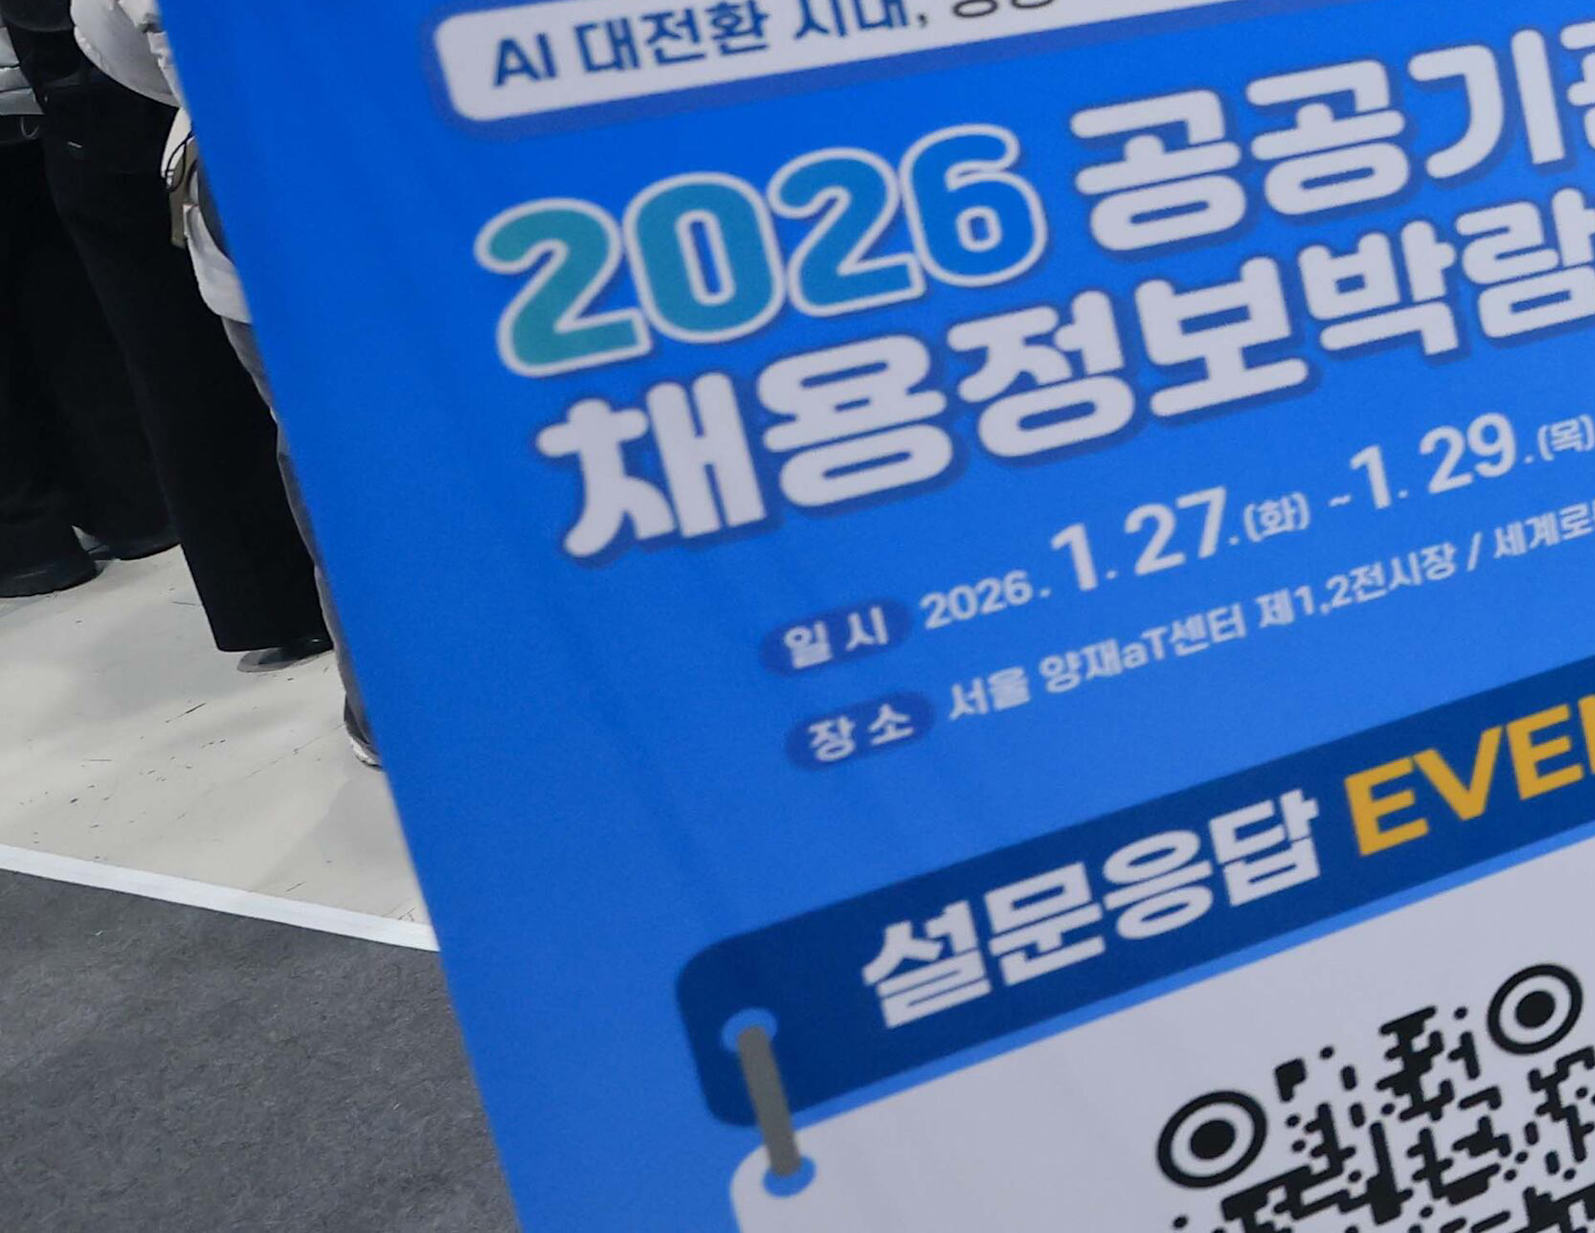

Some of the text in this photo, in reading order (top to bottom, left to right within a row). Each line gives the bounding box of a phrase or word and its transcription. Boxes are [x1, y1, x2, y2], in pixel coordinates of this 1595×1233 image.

[492, 33, 557, 86] AI
[477, 123, 1045, 378] 2026
[920, 570, 1052, 630] 2026.
[947, 666, 1031, 721] 서울
[1039, 602, 1247, 694] 양재aT센터
[1255, 541, 1458, 629] 제1,2전시장
[860, 787, 1321, 1030] 설문응답
